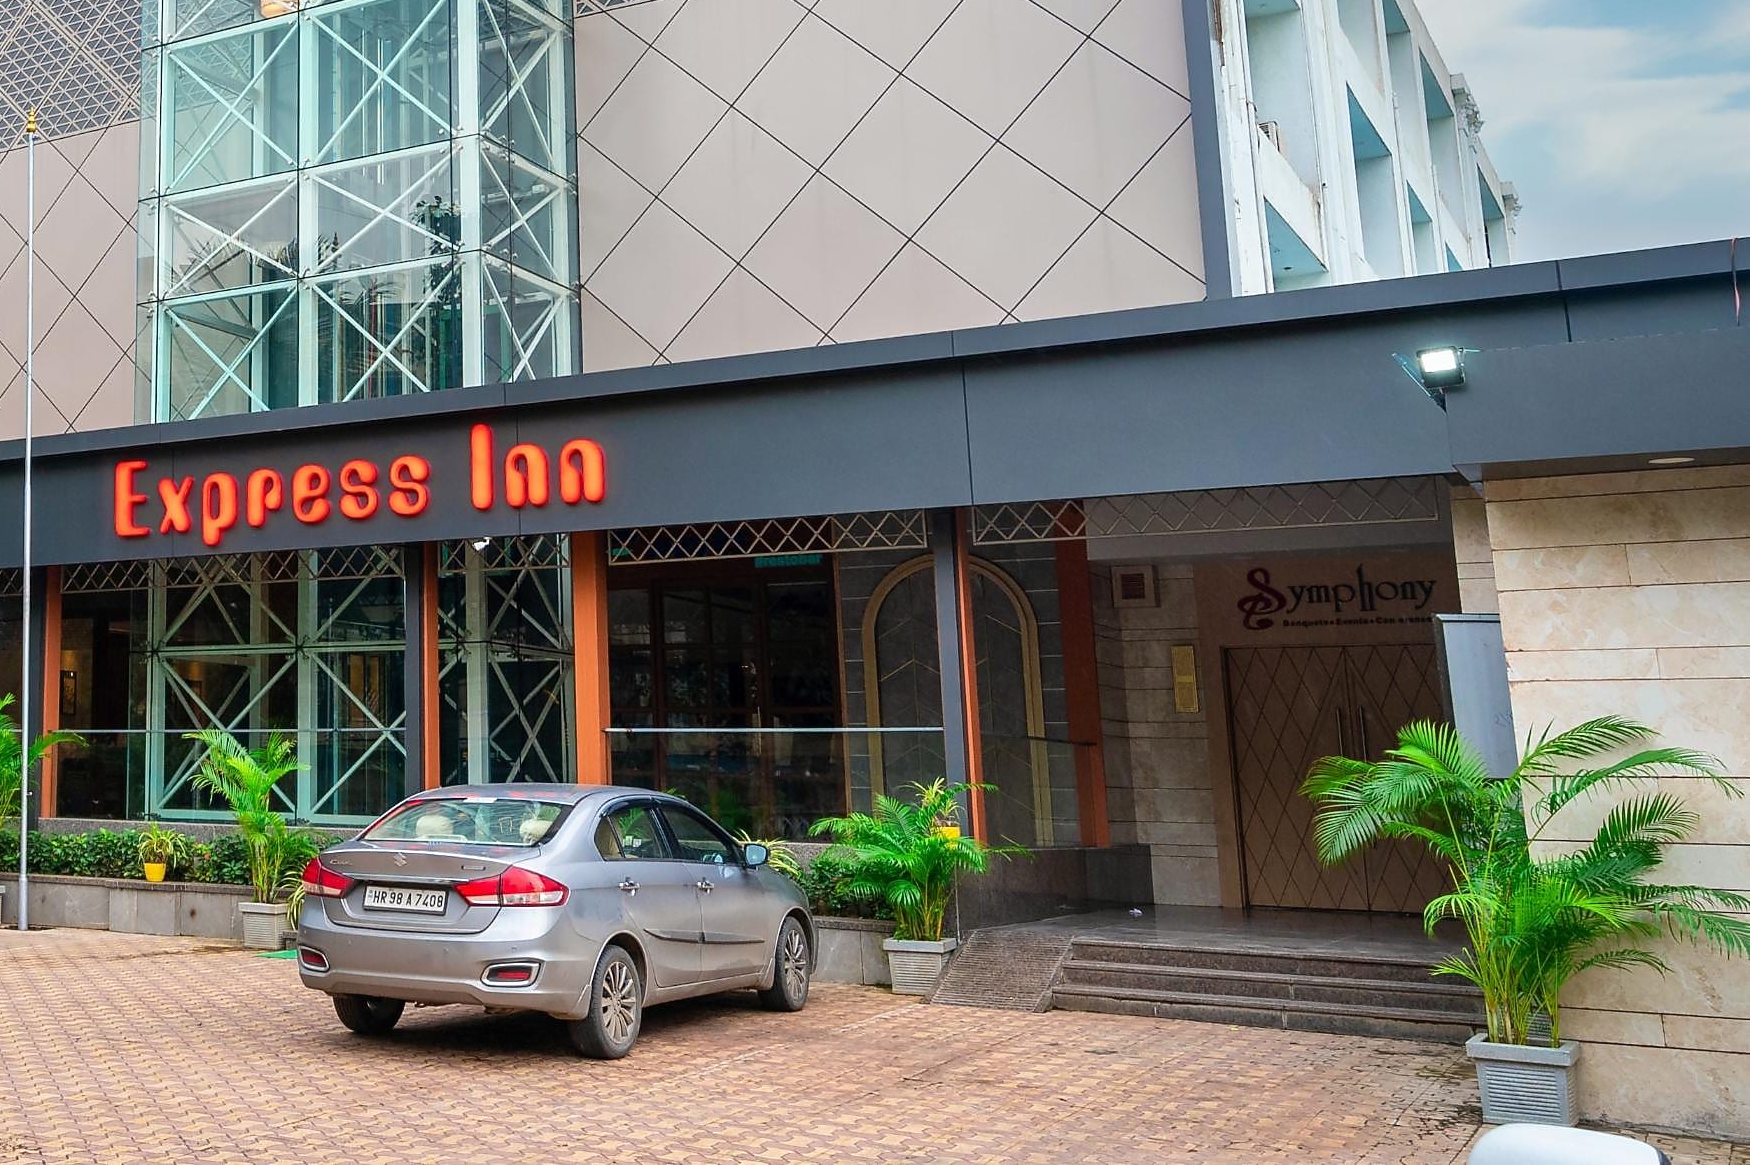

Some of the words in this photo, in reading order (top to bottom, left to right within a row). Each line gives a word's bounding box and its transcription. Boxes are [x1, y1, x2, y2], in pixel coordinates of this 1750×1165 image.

[114, 455, 431, 546] Express
[470, 423, 606, 511] Inn
[1237, 563, 1436, 631] Symphony
[373, 890, 388, 904] HR
[389, 892, 403, 905] 98
[406, 893, 412, 906] A
[415, 894, 444, 908] 7408
